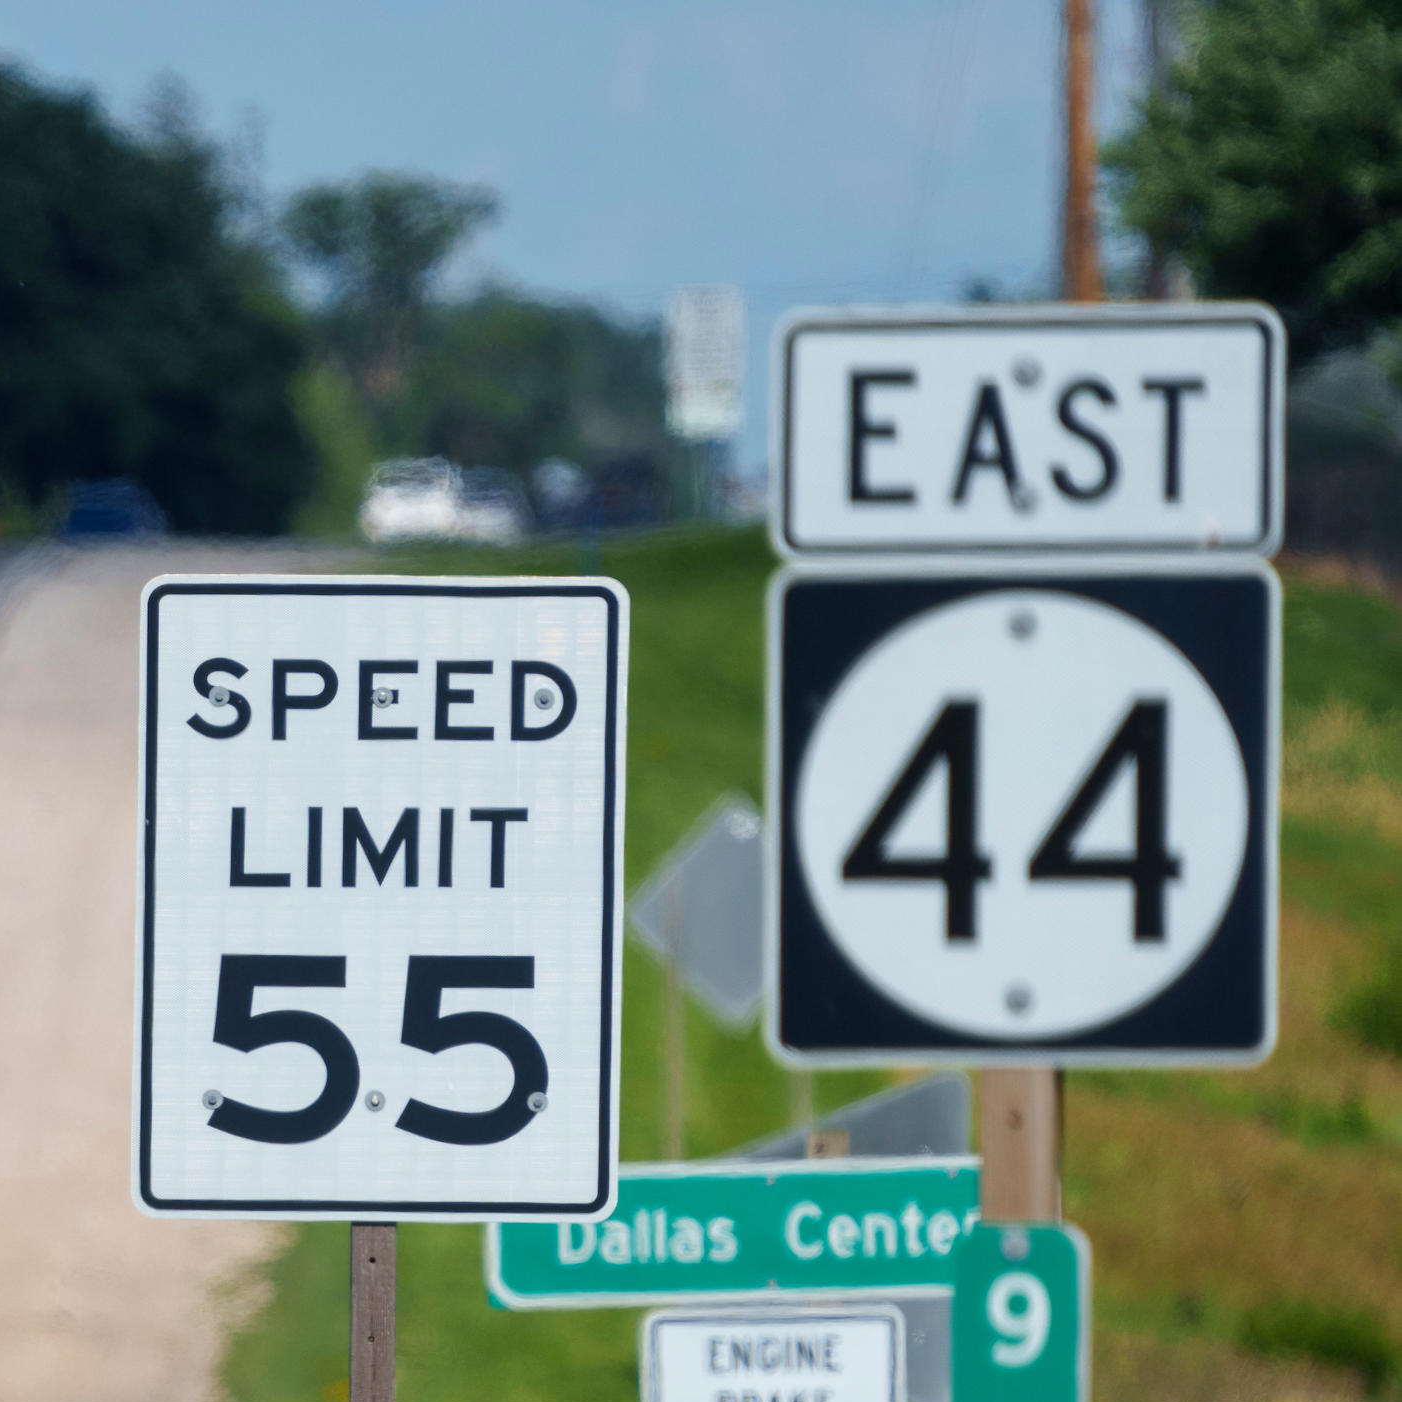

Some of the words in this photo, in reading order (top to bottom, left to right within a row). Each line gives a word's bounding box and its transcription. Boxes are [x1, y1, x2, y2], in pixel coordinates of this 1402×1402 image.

[846, 369, 1205, 507] EAST
[187, 657, 578, 742] SPEED
[229, 806, 529, 889] LIMIT
[841, 696, 1183, 944] 44
[206, 953, 549, 1146] 55
[557, 1208, 738, 1265] Dallas
[706, 1334, 841, 1375] ENGINE
